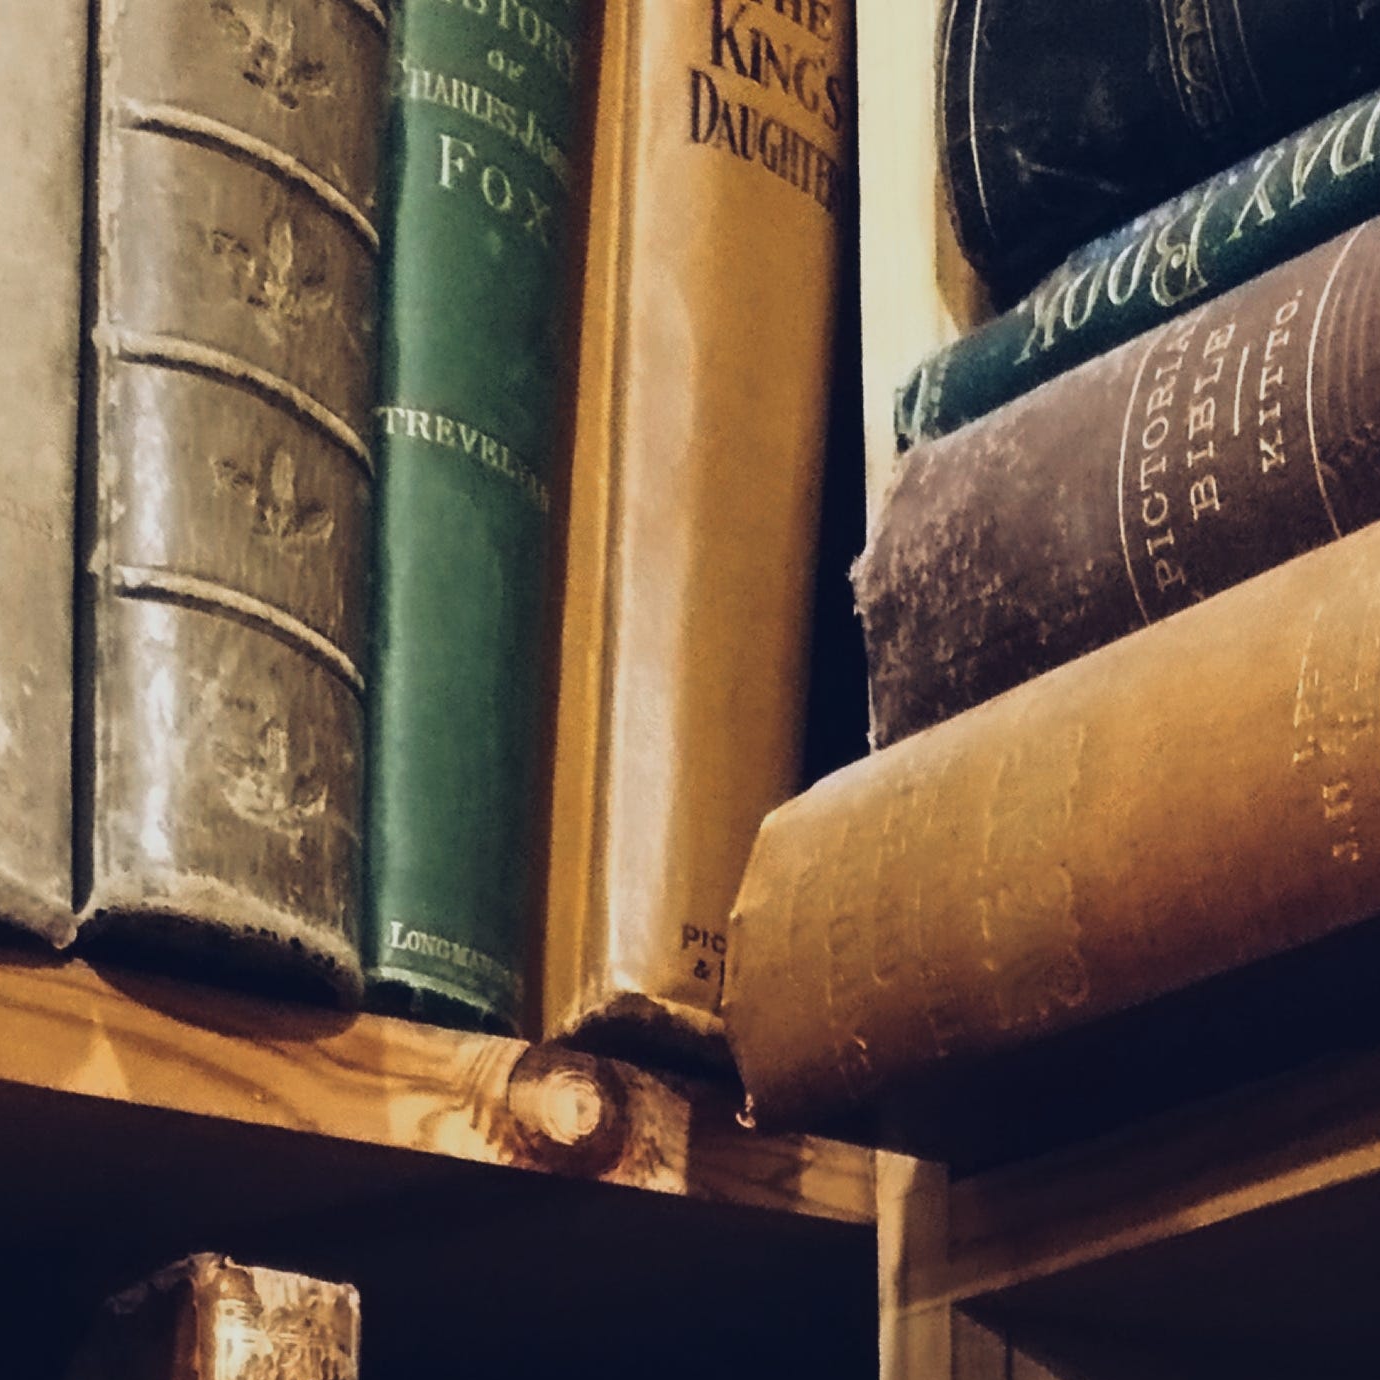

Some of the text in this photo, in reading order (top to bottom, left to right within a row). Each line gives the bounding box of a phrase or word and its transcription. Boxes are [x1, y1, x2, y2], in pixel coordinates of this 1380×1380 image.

[438, 132, 551, 250] FOX
[1187, 322, 1236, 520] BIBLE
[1260, 288, 1304, 472] KITTO.
